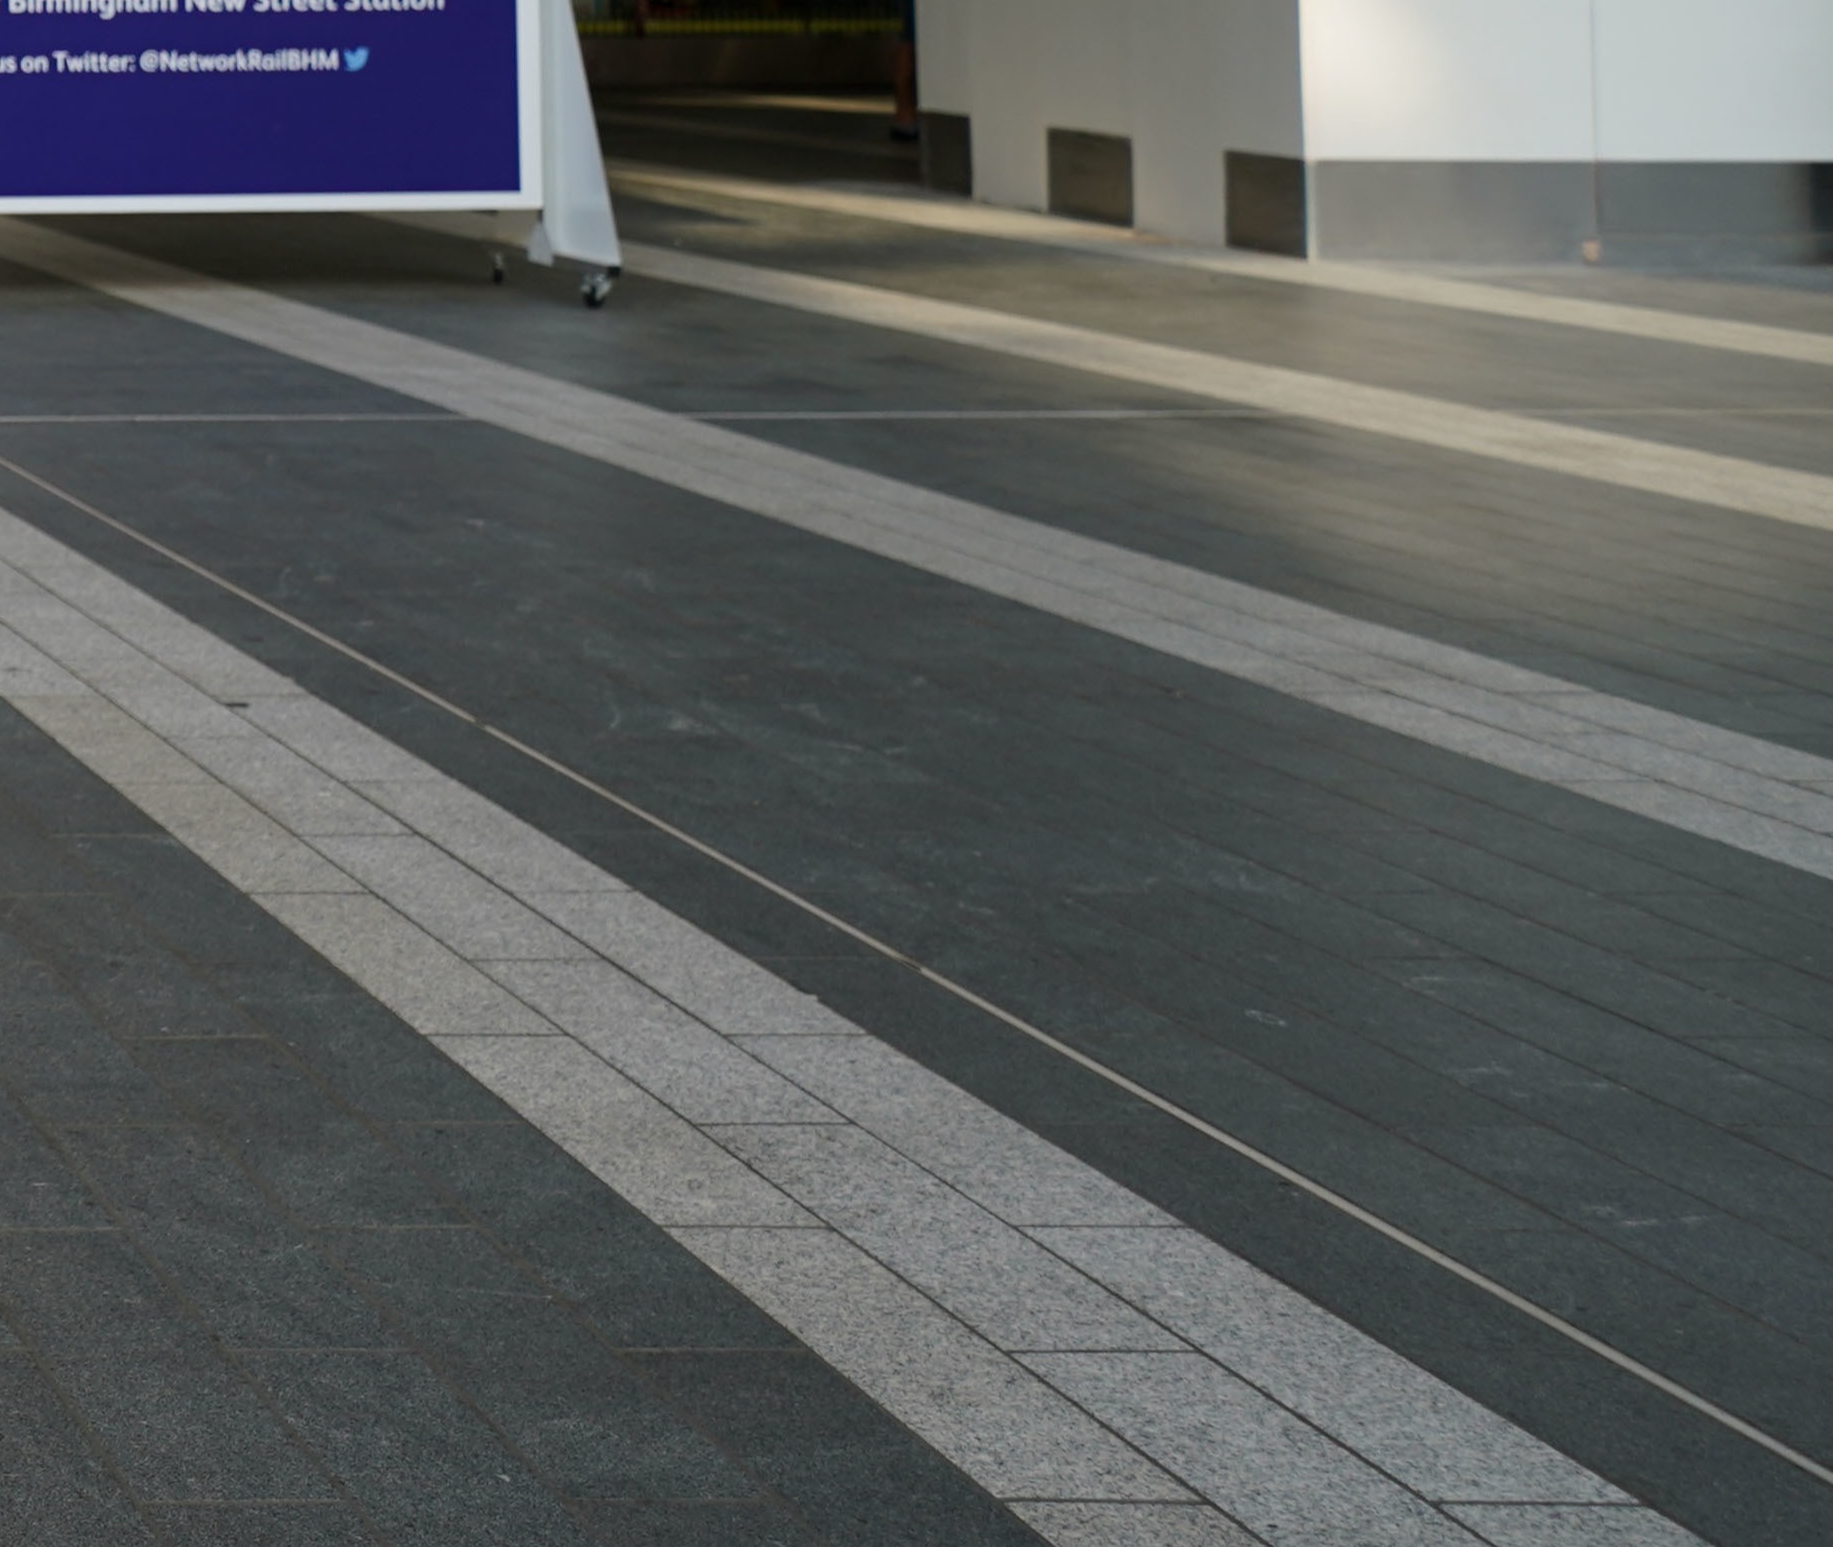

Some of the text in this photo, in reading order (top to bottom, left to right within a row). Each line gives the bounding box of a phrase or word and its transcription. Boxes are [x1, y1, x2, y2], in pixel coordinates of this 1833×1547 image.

[20, 55, 48, 74] on
[52, 49, 136, 74] Twitter:
[139, 46, 340, 73] @NetworkRailBHM
